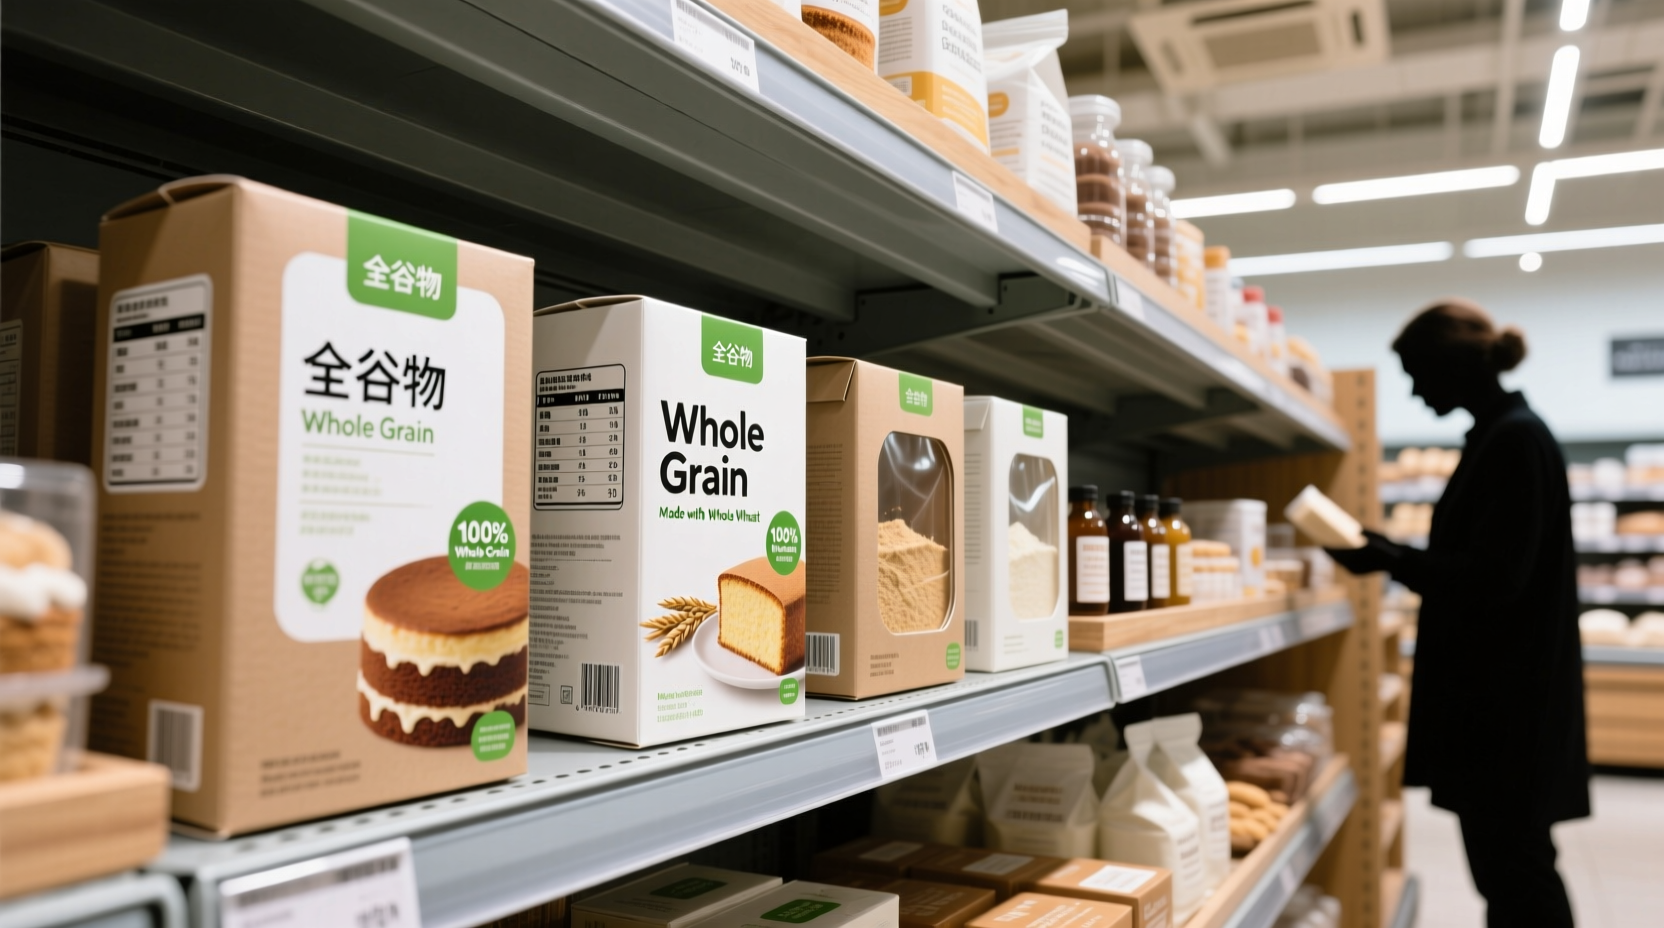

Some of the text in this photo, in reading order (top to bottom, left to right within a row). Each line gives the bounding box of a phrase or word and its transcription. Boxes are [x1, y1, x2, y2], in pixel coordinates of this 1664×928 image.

[362, 254, 442, 301] 全谷物
[712, 340, 753, 369] 全谷物
[303, 341, 447, 411] 全谷物
[301, 409, 435, 444] Whole Grain
[660, 400, 765, 452] Whole
[660, 451, 748, 497] Grain
[659, 505, 685, 520] Made
[687, 507, 705, 521] with
[457, 520, 509, 544] 100%
[770, 526, 798, 544] 100%
